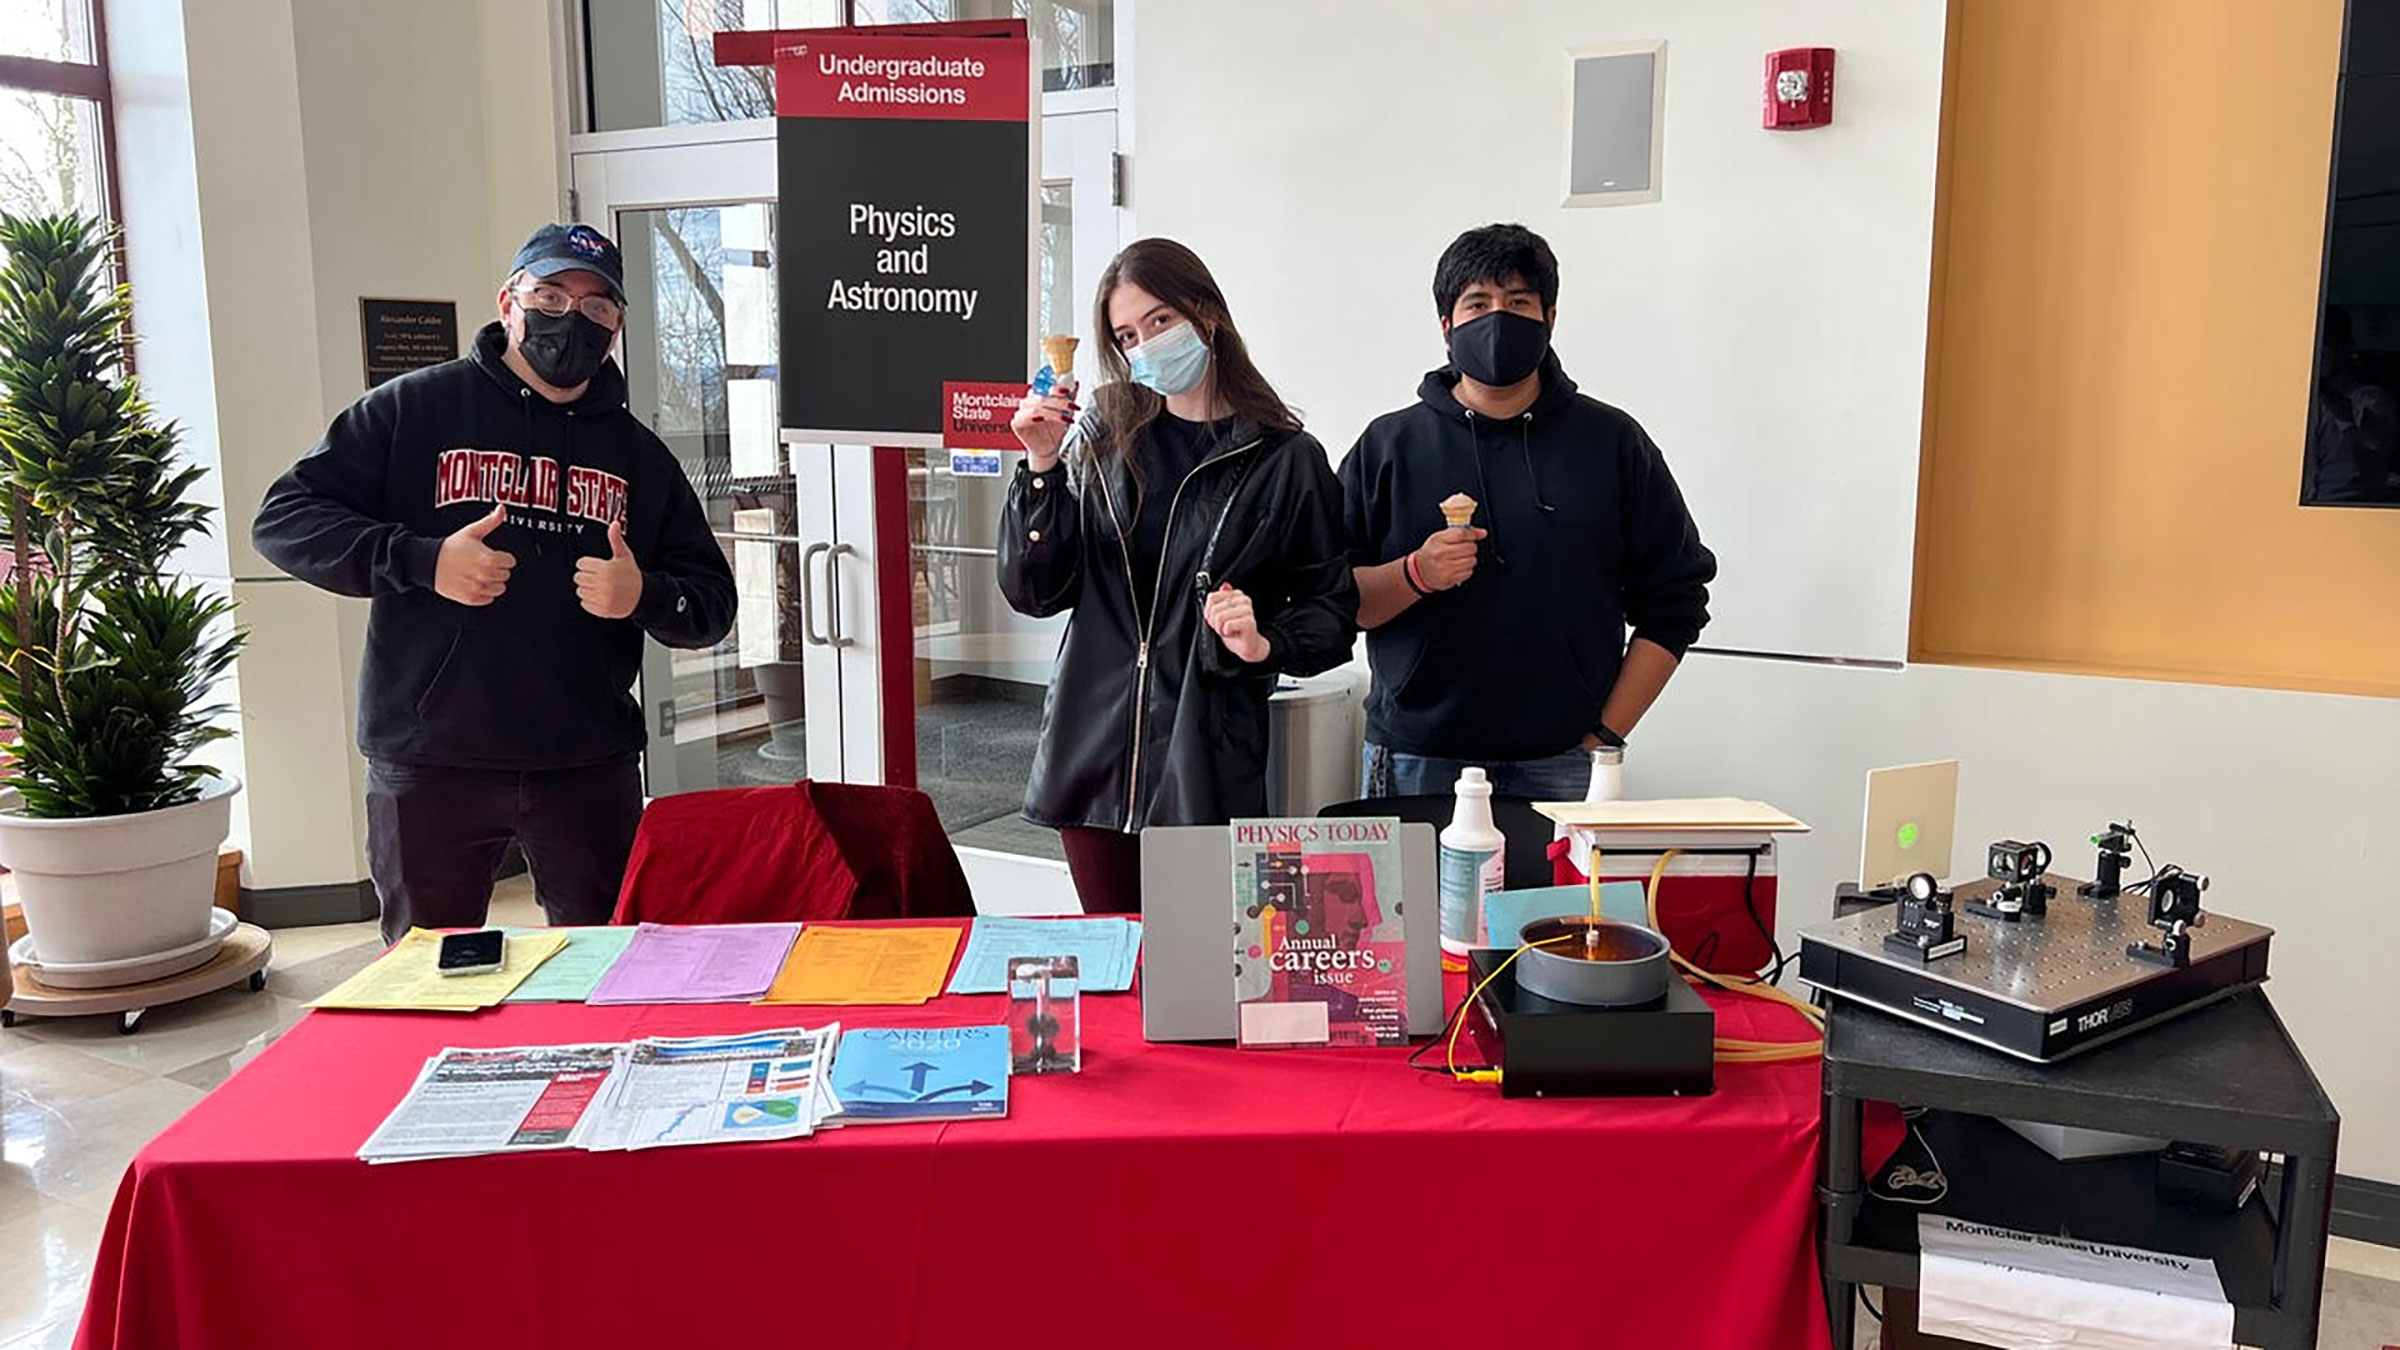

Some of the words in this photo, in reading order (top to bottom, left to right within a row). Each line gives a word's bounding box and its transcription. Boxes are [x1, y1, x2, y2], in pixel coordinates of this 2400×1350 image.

[819, 54, 985, 80] Undergraduate
[838, 82, 966, 105] Admissions
[850, 204, 956, 243] Physics
[876, 243, 928, 275] and
[827, 279, 979, 321] Astronomy
[952, 406, 992, 421] State
[1237, 823, 1319, 843] PHYSICS
[1326, 822, 1391, 842] TODAY
[1278, 933, 1337, 951] Annual
[1268, 949, 1376, 971] careers
[1313, 969, 1354, 985] issue
[1944, 1220, 2034, 1244] Montclair
[2035, 1235, 2089, 1253] State
[2090, 1244, 2191, 1272] University
